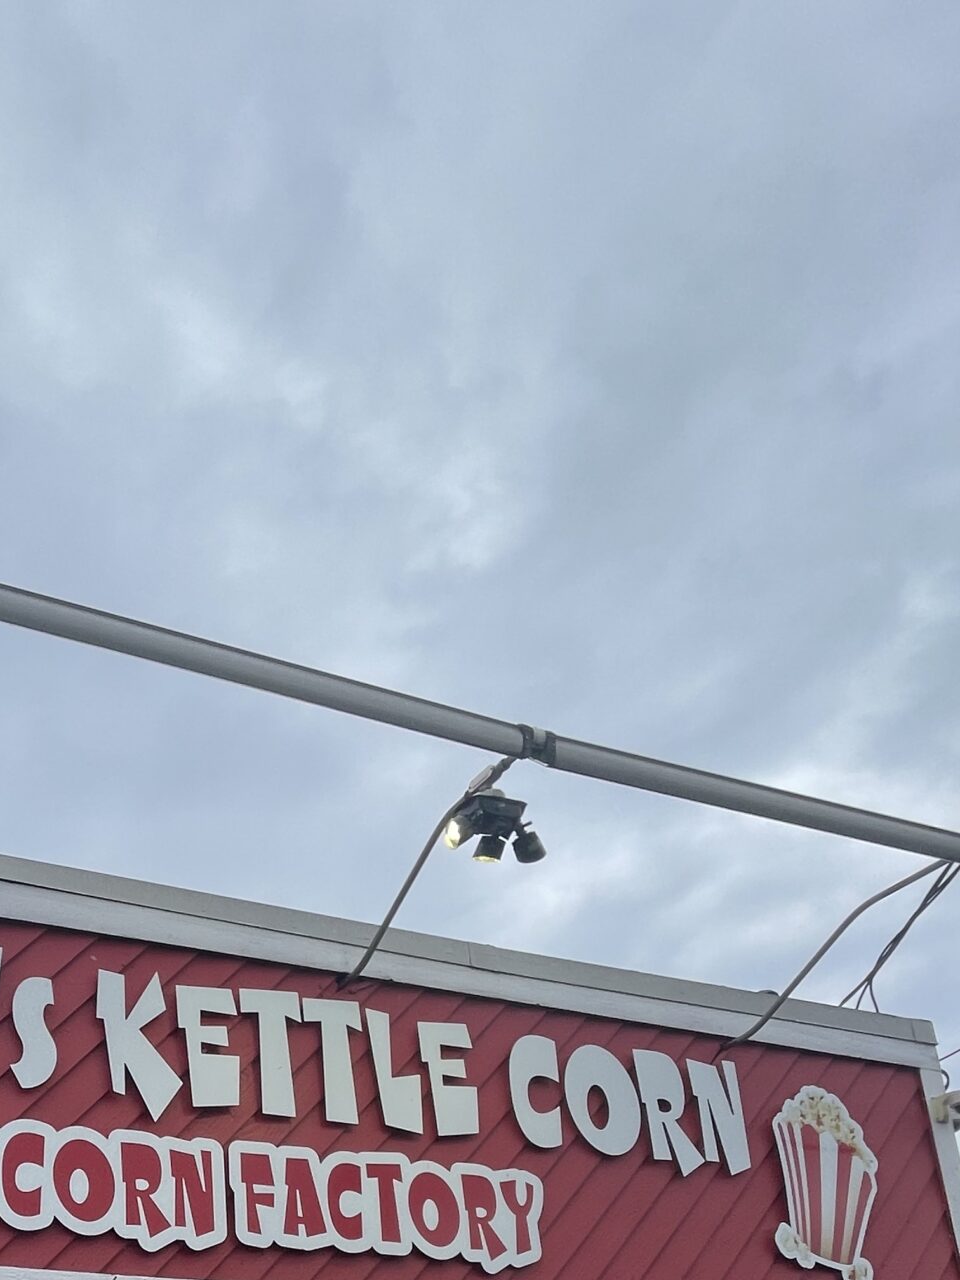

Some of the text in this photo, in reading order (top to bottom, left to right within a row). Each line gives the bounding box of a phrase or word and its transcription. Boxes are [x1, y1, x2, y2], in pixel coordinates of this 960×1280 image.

[96, 967, 480, 1137] KETTLE
[508, 1034, 752, 1178] CORN
[238, 1155, 536, 1262] FACTORY
